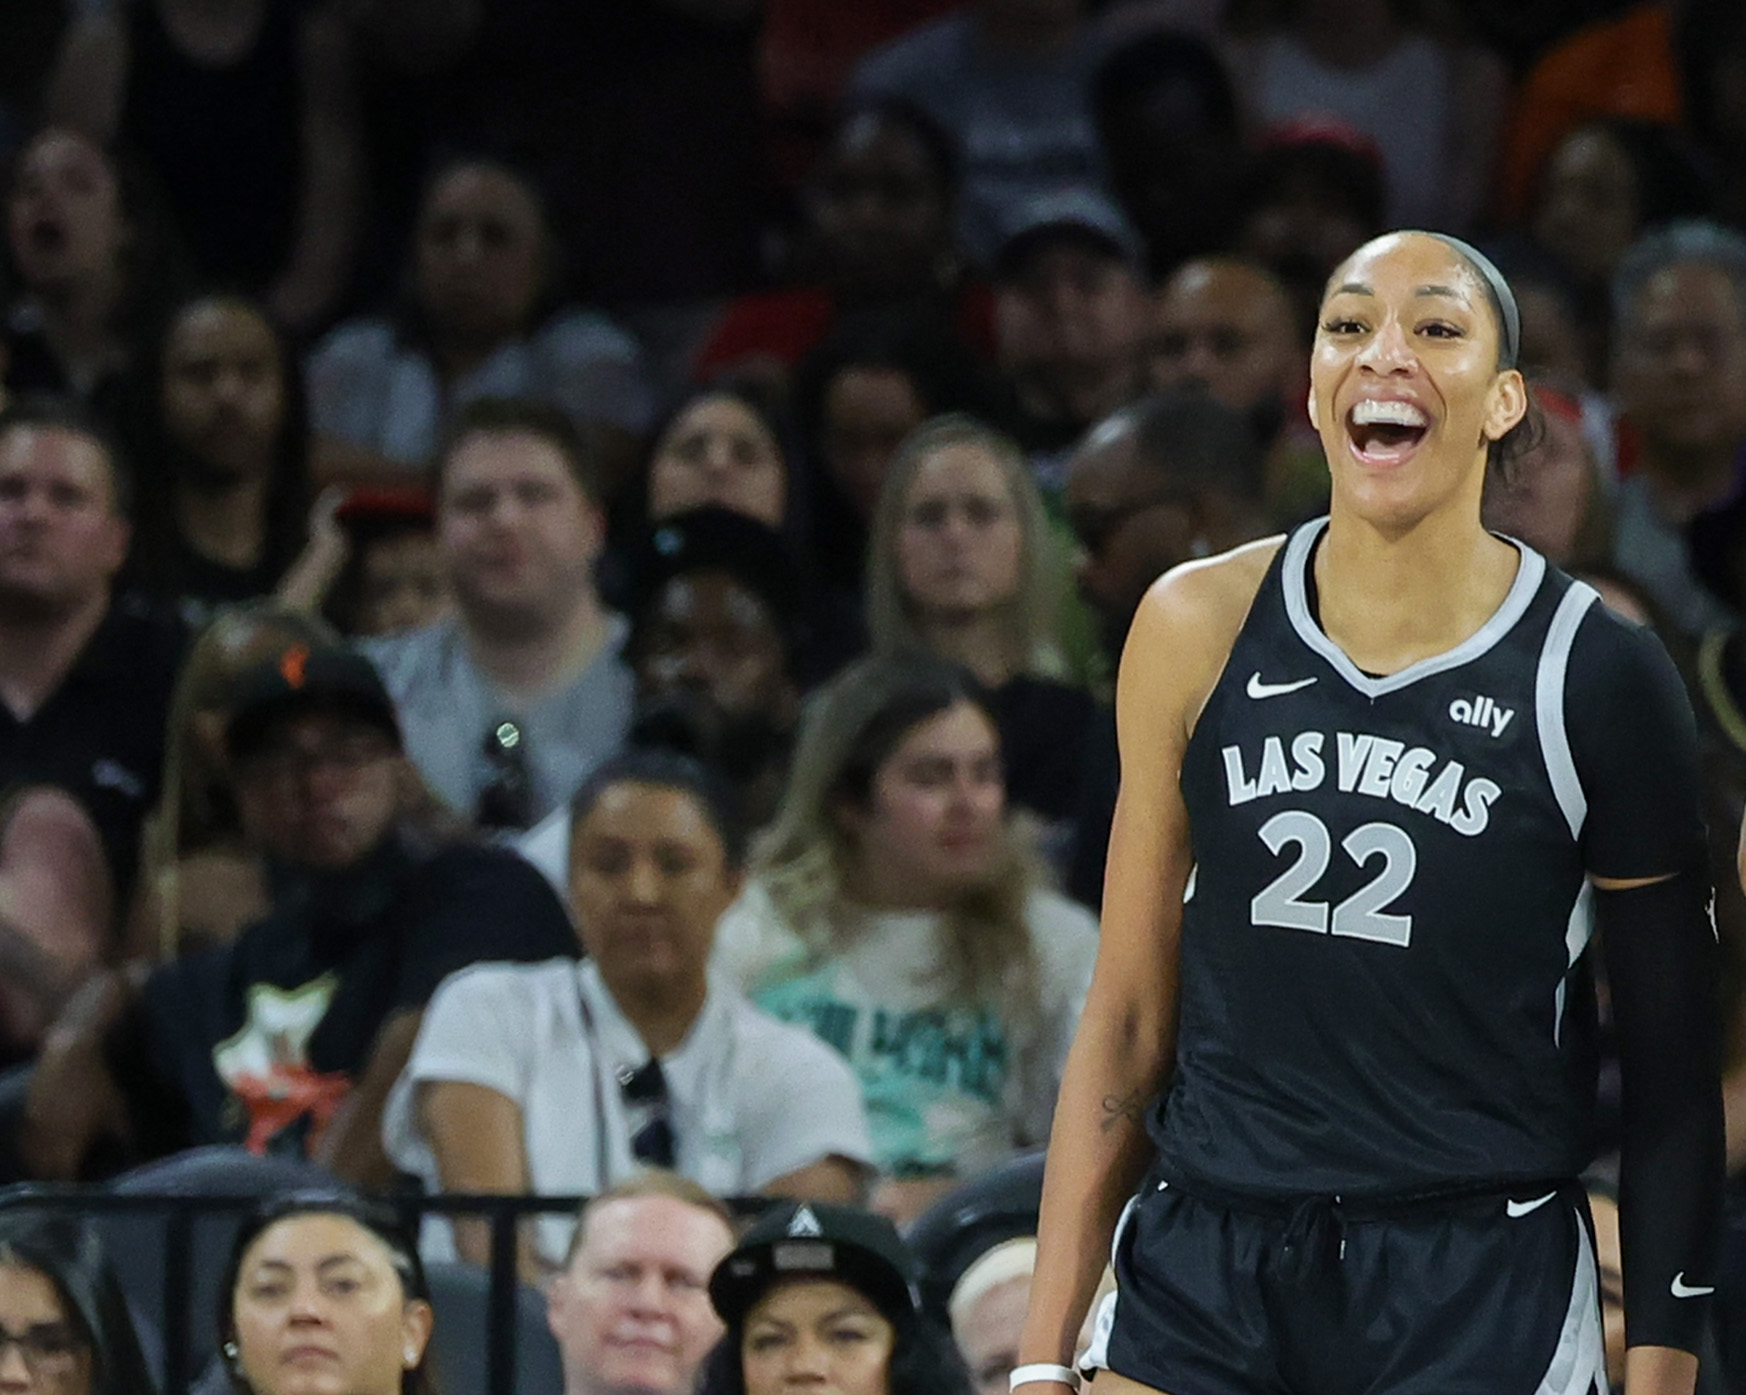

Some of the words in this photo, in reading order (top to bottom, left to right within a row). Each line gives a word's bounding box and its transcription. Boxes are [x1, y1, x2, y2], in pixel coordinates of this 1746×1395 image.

[1448, 696, 1514, 737] ally
[1222, 731, 1325, 806] LAS
[1337, 732, 1501, 836] VEGAS
[1251, 810, 1416, 948] 22
